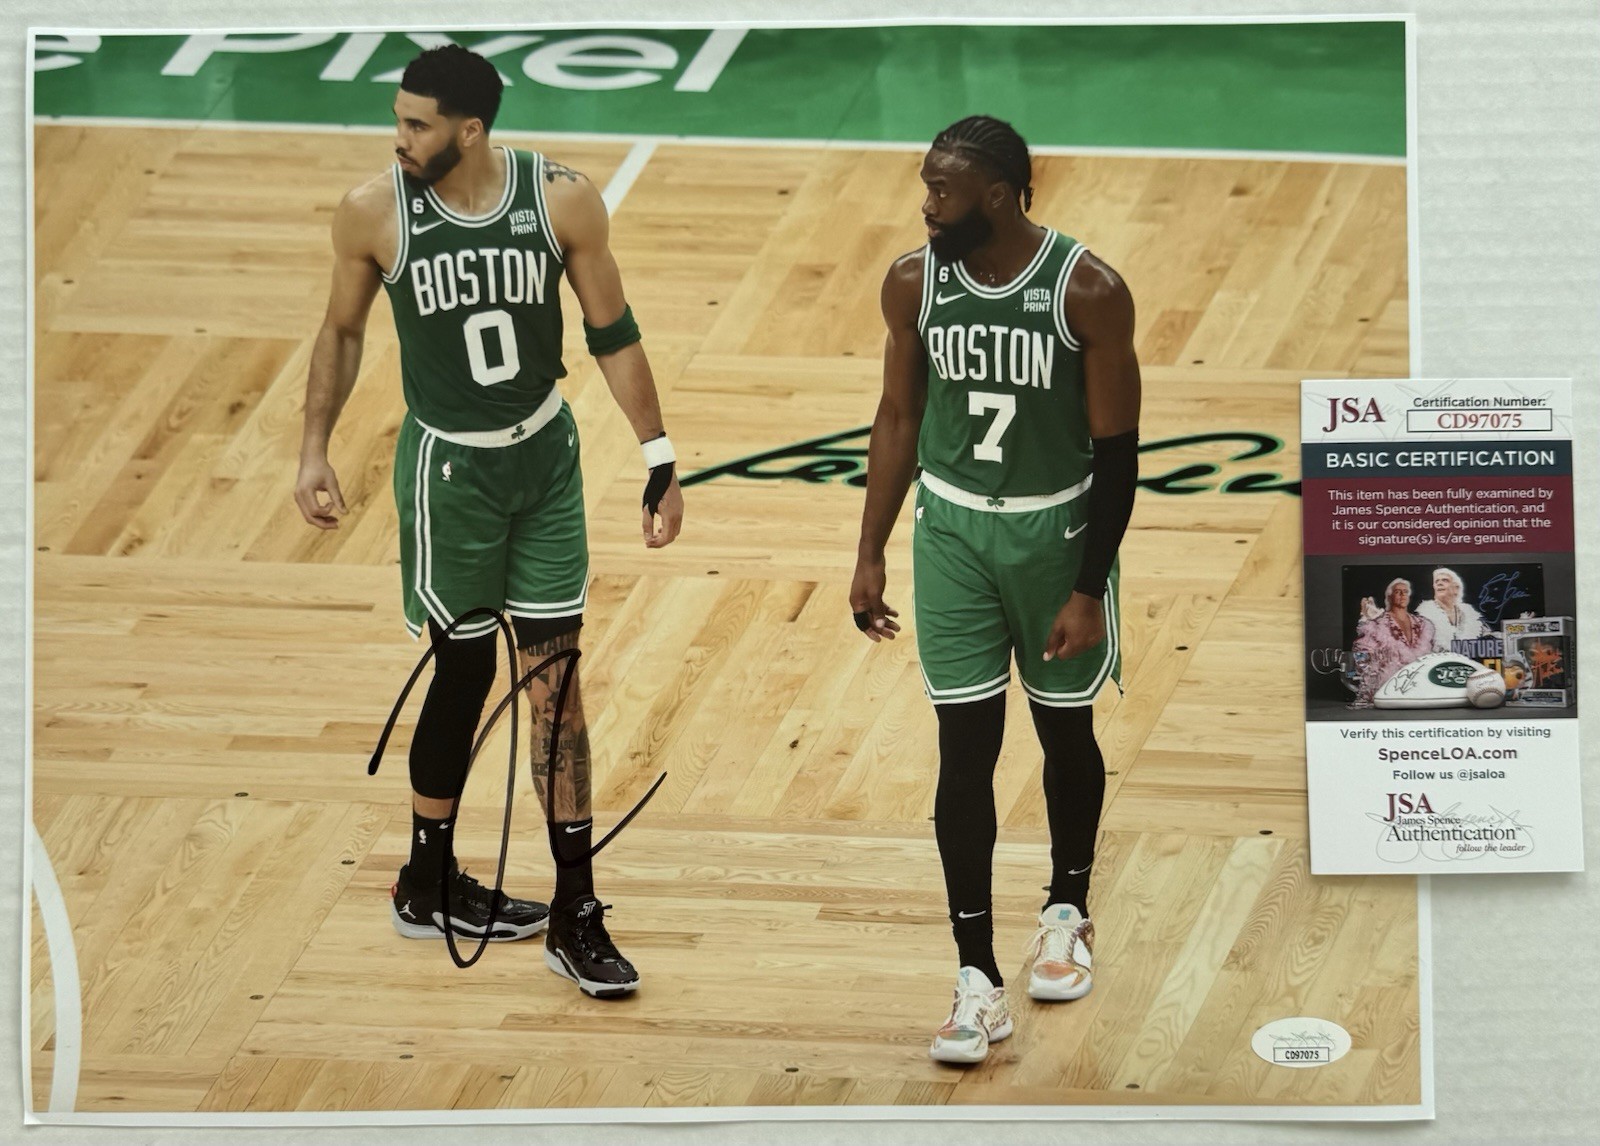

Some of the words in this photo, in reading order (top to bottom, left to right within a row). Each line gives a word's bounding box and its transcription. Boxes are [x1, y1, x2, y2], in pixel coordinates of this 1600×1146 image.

[411, 198, 425, 214] 6
[509, 209, 537, 226] VISTA
[510, 223, 538, 236] PRINT
[411, 248, 547, 316] BOSTON
[939, 266, 949, 283] 6
[1023, 288, 1050, 302] VISTA
[1023, 302, 1050, 312] PRINT
[463, 309, 520, 386] 0
[928, 324, 1054, 389] BOSTON
[1413, 397, 1490, 408] Certification
[1493, 397, 1546, 407] Number:
[1322, 397, 1385, 432] JSA
[1437, 413, 1522, 429] CD97075
[968, 391, 1016, 463] 7
[1326, 452, 1389, 468] BASIC
[1395, 450, 1555, 467] CERTIFICATION
[1328, 490, 1353, 501] This
[1357, 490, 1384, 500] item
[1387, 489, 1409, 500] has
[1412, 489, 1444, 500] been
[1446, 488, 1473, 502] fully
[1476, 488, 1535, 499] examined
[1538, 488, 1553, 500] by
[1332, 505, 1372, 516] James
[1375, 504, 1421, 518] Spence
[1425, 503, 1519, 516] Authentication,
[1522, 503, 1545, 513] and
[1332, 520, 1340, 530] it
[1344, 520, 1353, 530] is
[1357, 521, 1378, 529] our
[1382, 518, 1451, 529] considered
[1454, 519, 1500, 531] opinion
[1503, 518, 1528, 528] that
[1531, 518, 1551, 528] the
[1359, 533, 1432, 546] signature(s)
[1436, 533, 1471, 544] is/are
[1475, 533, 1525, 545] genuine.
[1451, 640, 1502, 658] NATURE
[1340, 728, 1378, 741] Verify
[1382, 728, 1404, 738] this
[1408, 727, 1483, 738] certification
[1487, 727, 1502, 739] by
[1506, 727, 1551, 739] visiting
[1378, 747, 1518, 763] SpenceLOA.com
[1393, 770, 1435, 780] Follow
[1439, 771, 1453, 780] us
[1457, 769, 1505, 781] @jsaloa
[1383, 792, 1435, 822] JSA
[1397, 815, 1425, 826] James
[1427, 815, 1461, 827] Spence
[1455, 843, 1482, 853] follow
[1484, 843, 1498, 852] the
[1499, 843, 1526, 851] leader
[1285, 1051, 1319, 1060] CD97075
